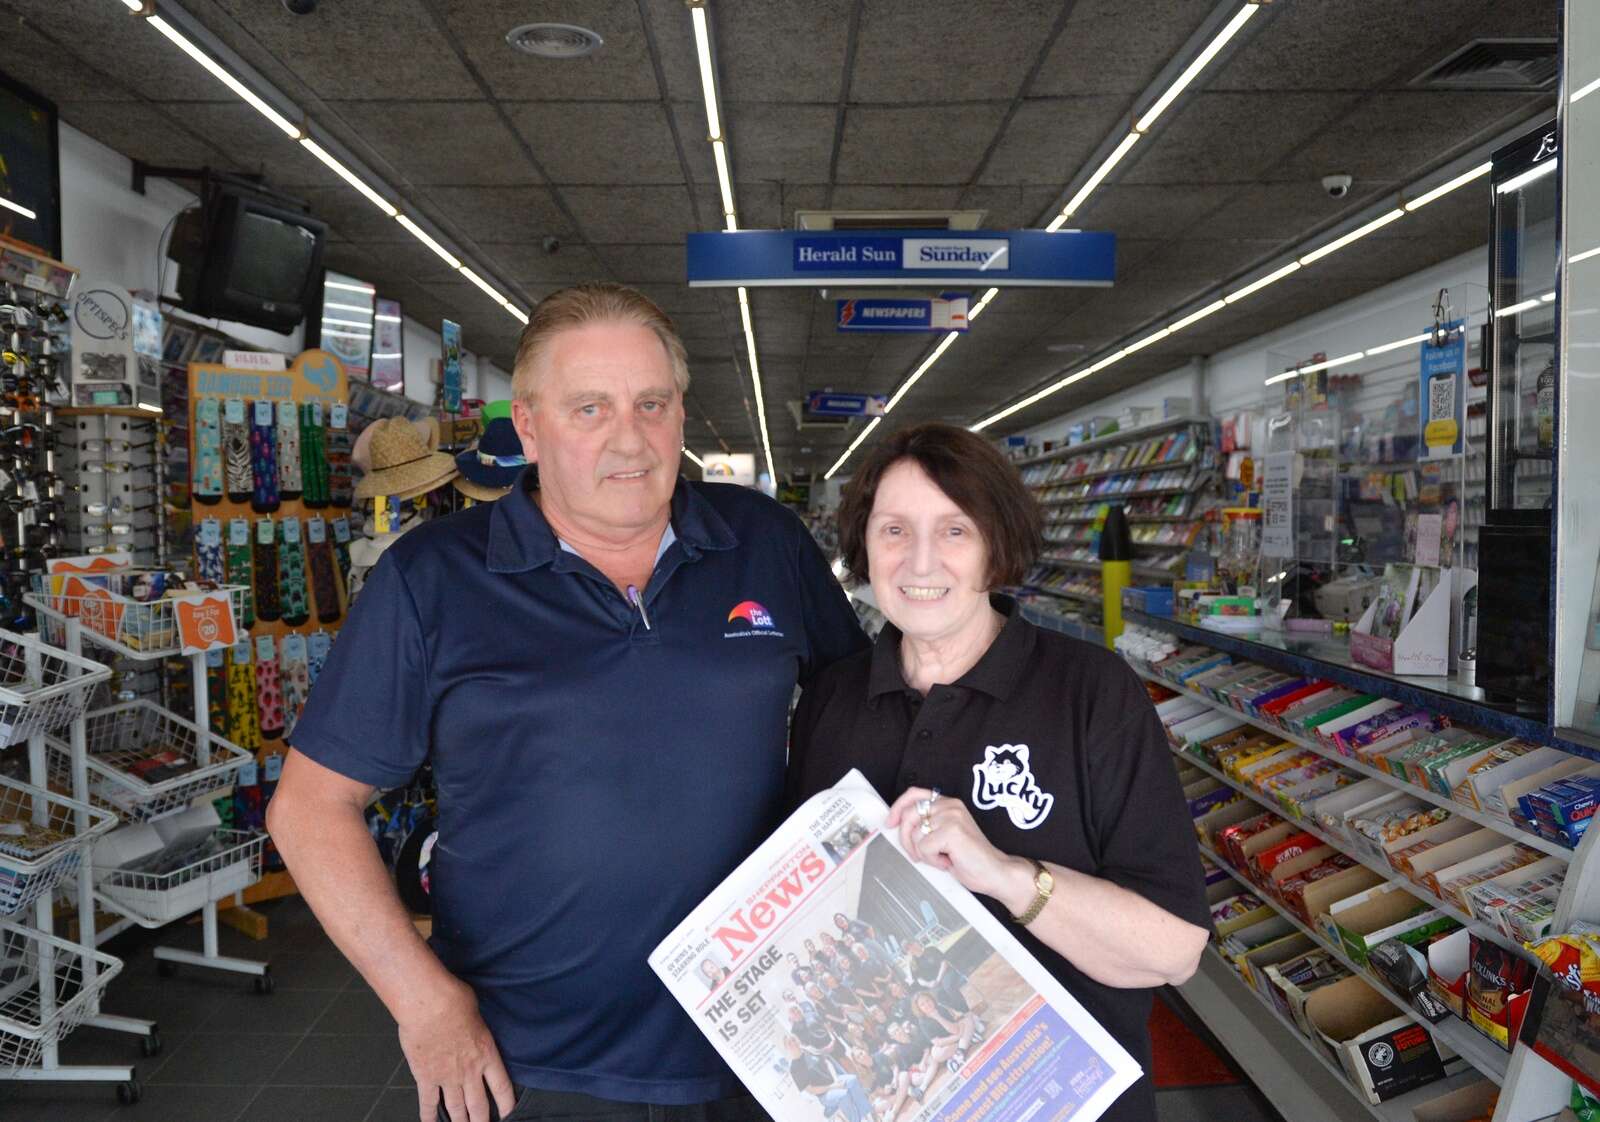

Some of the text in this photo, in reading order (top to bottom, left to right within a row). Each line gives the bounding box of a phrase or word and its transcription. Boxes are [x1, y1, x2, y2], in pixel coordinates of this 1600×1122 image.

[799, 246, 896, 262] Herald Sun
[919, 246, 995, 265] Sunday
[77, 292, 128, 340] OPTISPECS
[862, 307, 925, 319] NEWSPAPERS
[750, 608, 762, 616] the
[752, 615, 773, 626] Lott
[978, 769, 1049, 824] Lucky
[712, 851, 826, 962] News
[705, 991, 737, 1024] THE
[734, 945, 783, 996] STAGE
[718, 1020, 739, 1042] IS
[736, 990, 767, 1024] SET
